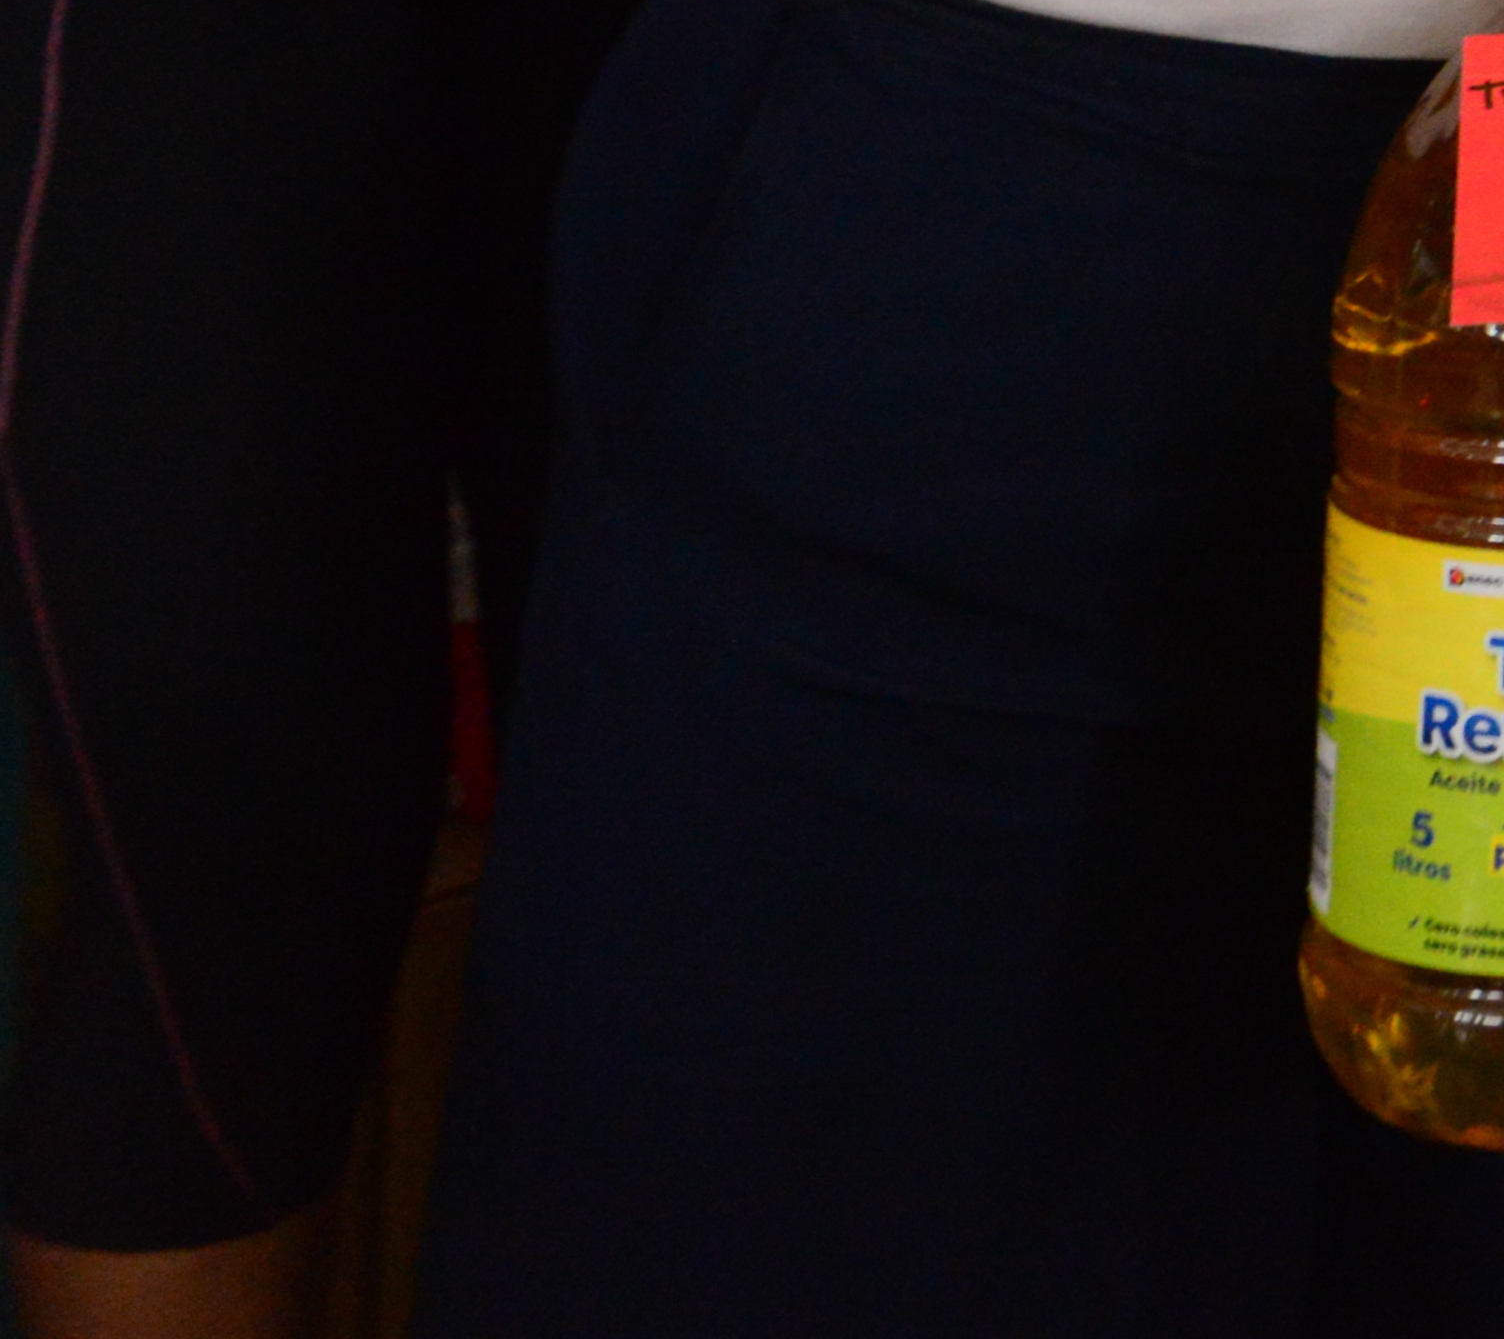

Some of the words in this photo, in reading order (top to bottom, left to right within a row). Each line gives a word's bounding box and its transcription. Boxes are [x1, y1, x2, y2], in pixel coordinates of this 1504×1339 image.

[1428, 768, 1501, 797] Aceite
[1410, 809, 1435, 849] 5
[1392, 848, 1453, 881] litros
